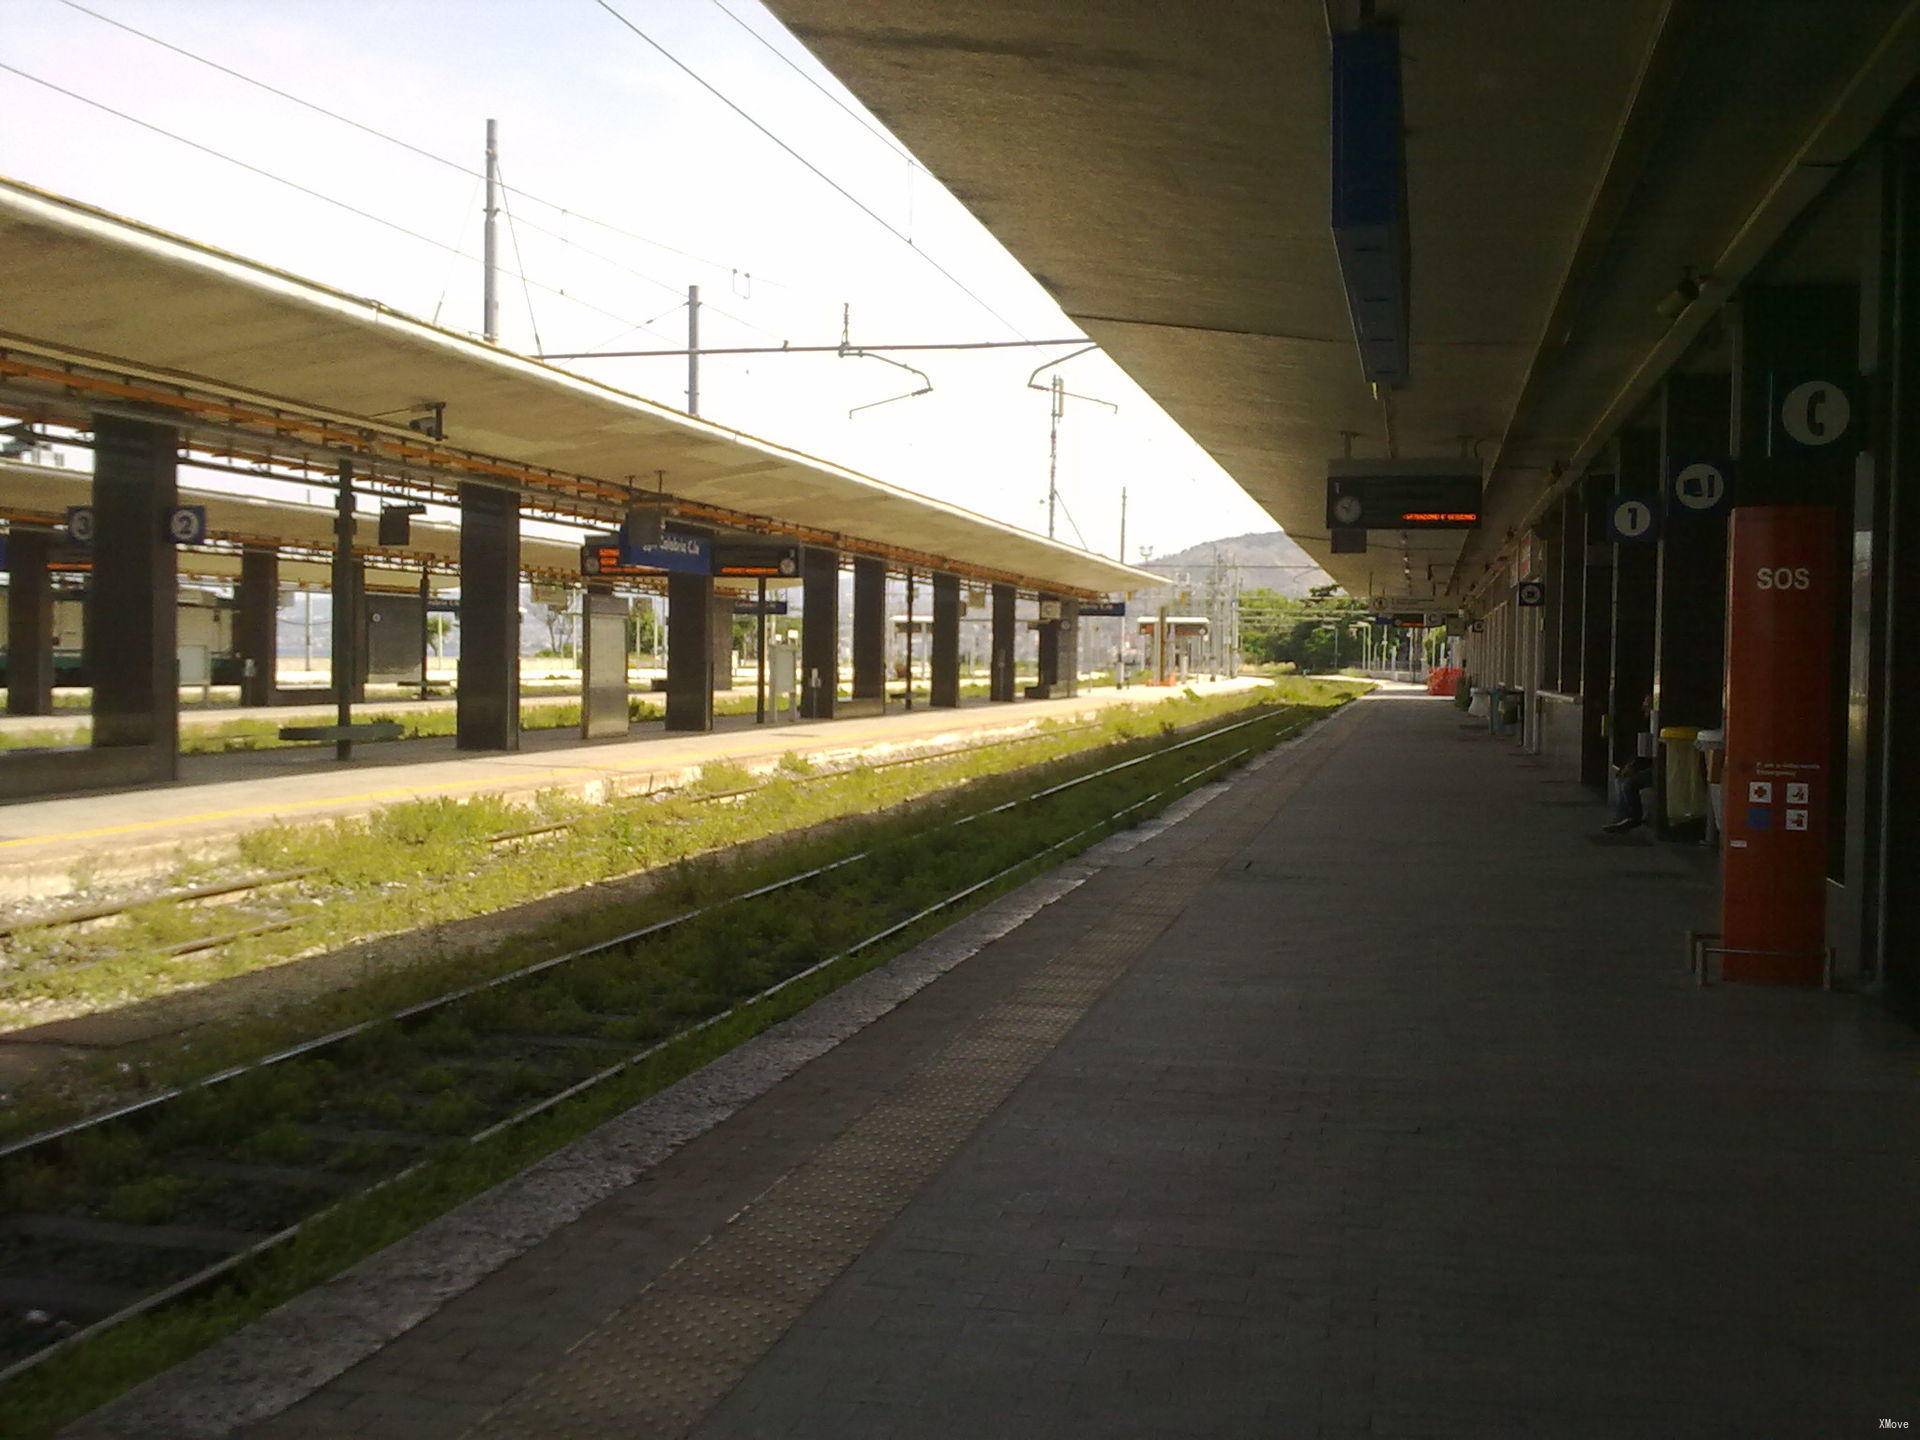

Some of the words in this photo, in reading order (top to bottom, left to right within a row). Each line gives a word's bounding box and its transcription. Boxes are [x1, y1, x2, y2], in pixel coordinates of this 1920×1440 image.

[179, 515, 192, 535] 2
[1627, 507, 1637, 530] 1
[1757, 567, 1810, 590] SOS
